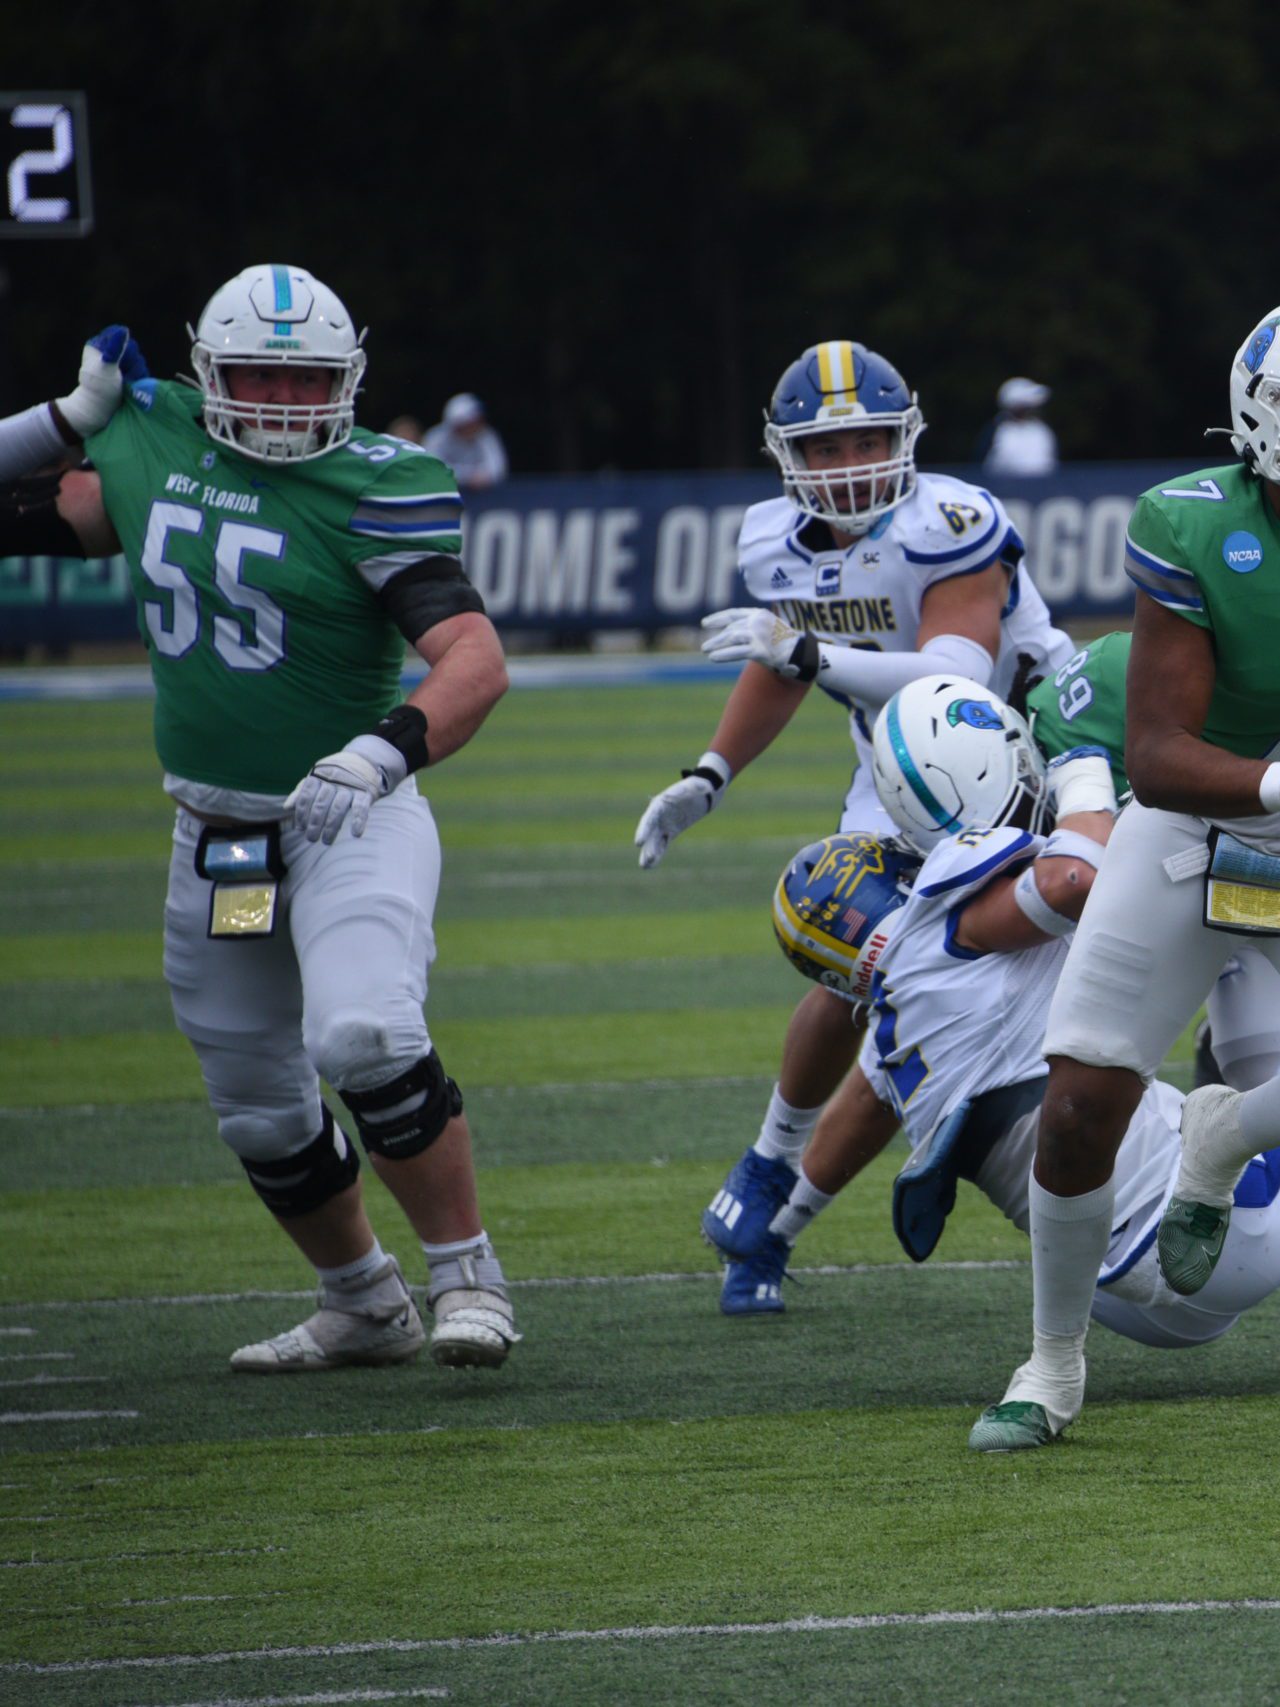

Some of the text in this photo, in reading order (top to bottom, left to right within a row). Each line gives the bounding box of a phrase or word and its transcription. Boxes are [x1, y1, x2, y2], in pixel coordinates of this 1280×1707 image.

[8, 104, 73, 222] 2
[165, 473, 260, 514] WEST FLORIDA
[1159, 478, 1226, 501] 7
[1228, 549, 1262, 563] NCAA
[141, 500, 287, 673] 55
[851, 933, 889, 998] Riddell
